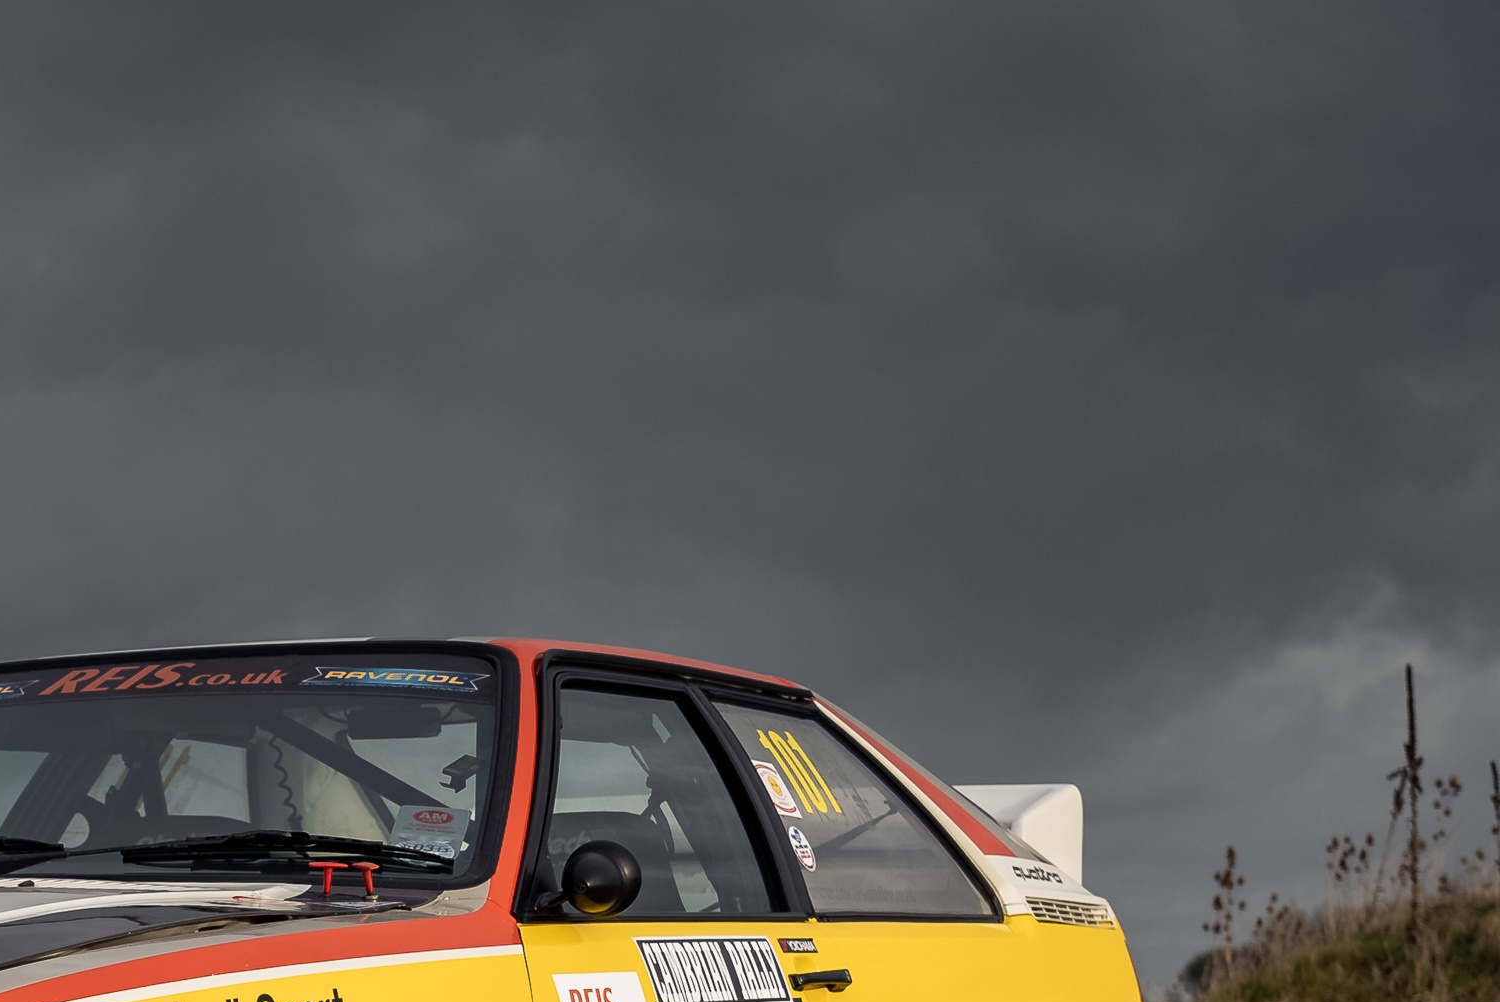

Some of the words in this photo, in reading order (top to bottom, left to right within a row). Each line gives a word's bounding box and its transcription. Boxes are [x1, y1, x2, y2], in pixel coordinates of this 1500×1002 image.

[38, 662, 289, 696] REIS.co.uk
[325, 670, 465, 686] RAVENOL
[756, 728, 843, 814] 101
[1012, 866, 1063, 884] quattro
[723, 940, 787, 1001] RALLY
